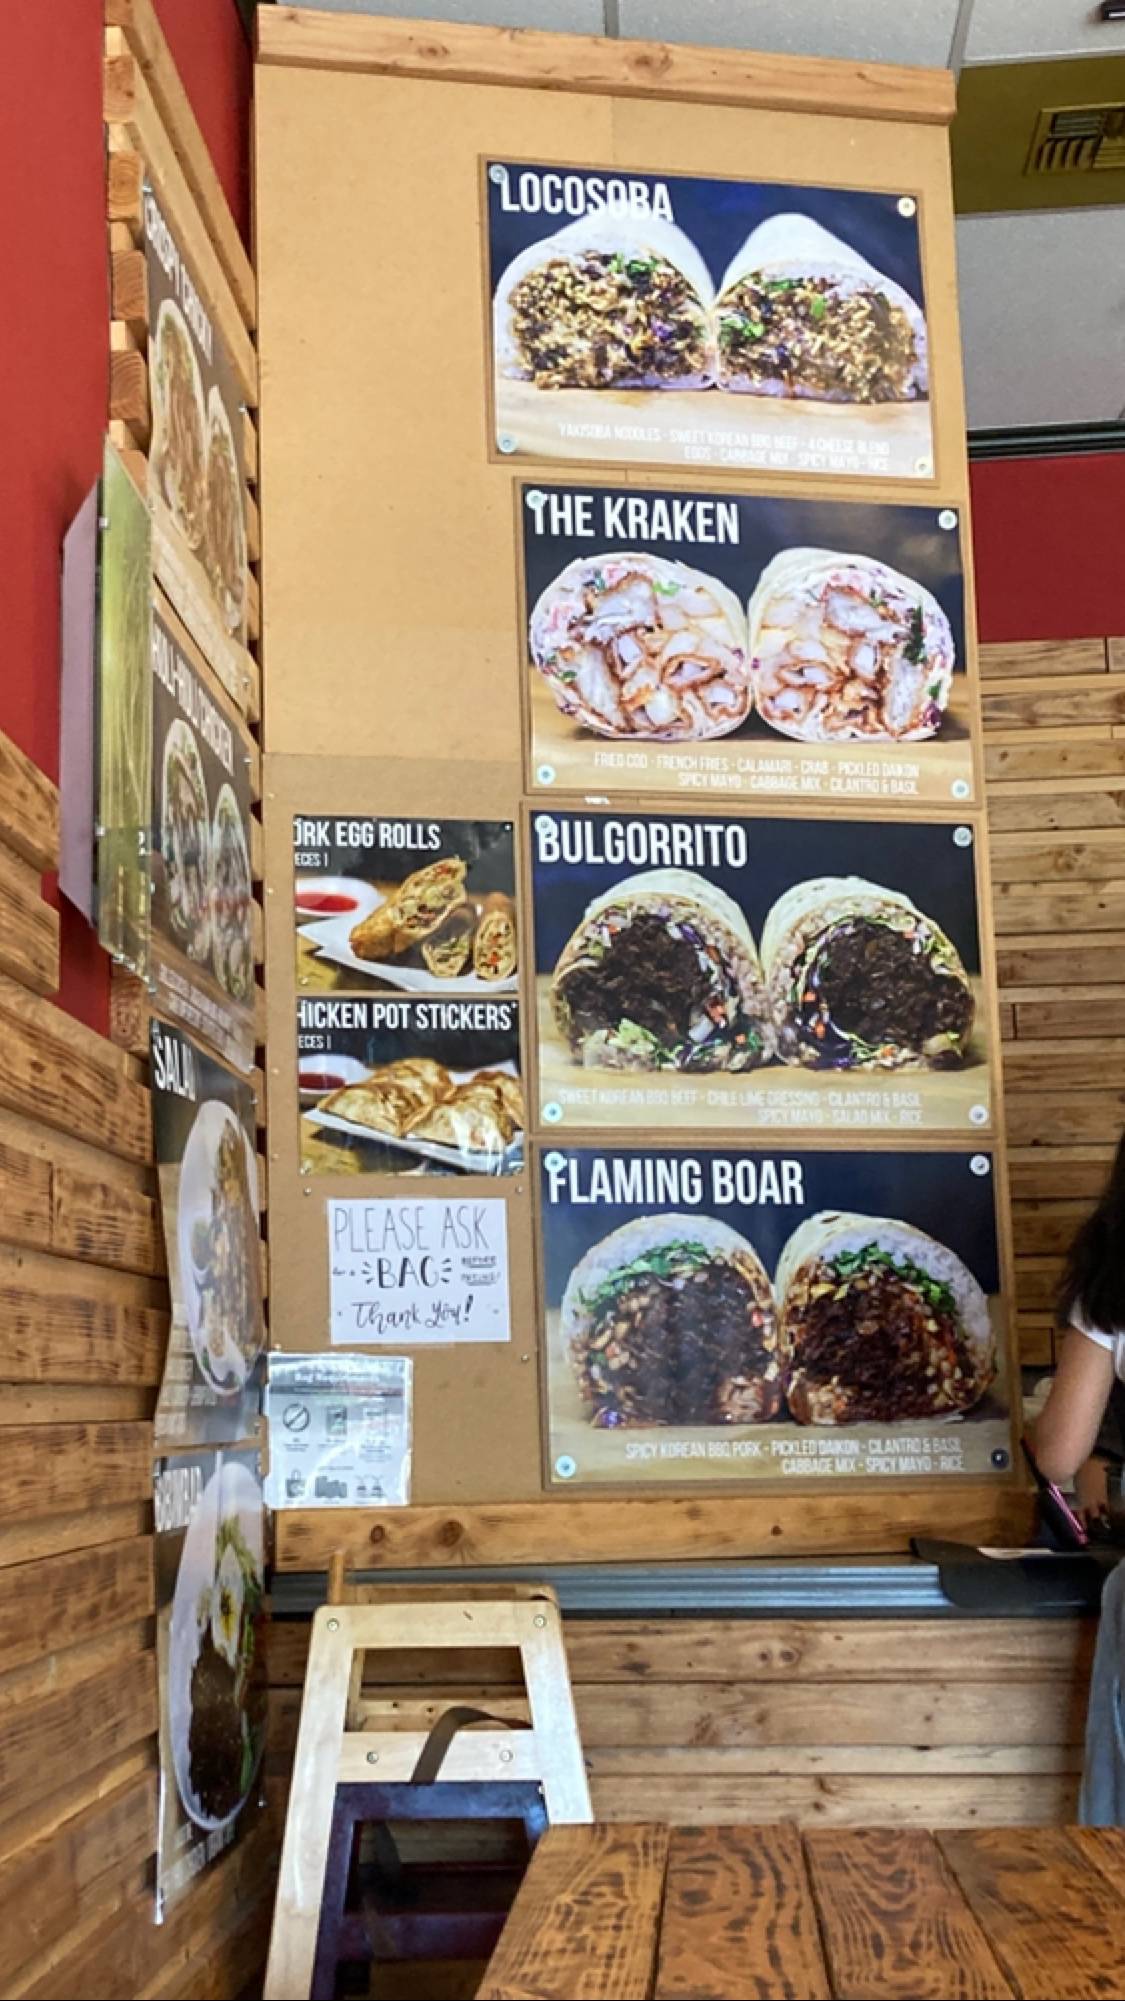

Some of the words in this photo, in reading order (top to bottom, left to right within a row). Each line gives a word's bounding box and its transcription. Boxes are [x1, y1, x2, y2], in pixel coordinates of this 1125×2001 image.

[501, 171, 673, 223] LOCOSOBA
[534, 492, 595, 537] THE
[604, 495, 739, 544] KRAKEN
[594, 751, 624, 768] FRIED
[626, 753, 647, 768] COD
[656, 754, 698, 770] FRENCH
[700, 757, 729, 771] FRIES
[737, 758, 792, 774] CALAMARI
[800, 760, 829, 775] CRAB
[838, 761, 880, 777] PICKLED
[882, 763, 919, 777] DAIKON
[678, 772, 706, 787] SPICY
[708, 773, 742, 789] MAYO
[750, 774, 799, 790] CABBAGE
[801, 776, 821, 791] MIX
[830, 777, 879, 793] CILANTRO
[890, 779, 918, 795] BASIL
[335, 821, 374, 847] EGG
[379, 823, 441, 850] ROLLS
[537, 818, 747, 867] BULGORRITO
[373, 1003, 410, 1029] POT
[559, 1087, 599, 1104] SWEET
[600, 1088, 645, 1104] KOREAN
[671, 1089, 697, 1105] BEEF
[740, 1089, 765, 1106] LIME
[766, 1089, 820, 1106] DRESSING
[828, 1091, 881, 1107] CILANTRO
[893, 1092, 921, 1107] BASIL
[758, 1108, 787, 1124] SPICY
[789, 1109, 823, 1124] MAYO
[832, 1109, 868, 1125] SALAD
[870, 1109, 889, 1125] MIX
[899, 1109, 923, 1125] RICE
[549, 1157, 702, 1204] FLAMING
[711, 1159, 803, 1205] BOAR
[334, 1206, 430, 1252] PLEASE
[441, 1205, 489, 1249] ASK
[377, 1255, 439, 1289] BAG
[351, 1300, 421, 1335] Thank
[625, 1442, 657, 1459] SPICY
[660, 1440, 705, 1458] KOREAN
[708, 1440, 730, 1456] BBQ
[732, 1440, 762, 1457] PORK
[771, 1439, 817, 1456] PICKLED
[818, 1439, 859, 1455] DAIKON
[868, 1437, 920, 1454] CILANTRO
[932, 1436, 962, 1453] BASIL
[781, 1457, 833, 1474] CABBAGE
[835, 1456, 856, 1473] MIX
[865, 1455, 896, 1472] SPICY
[899, 1455, 932, 1472] MAYO
[940, 1455, 965, 1472] RICE
